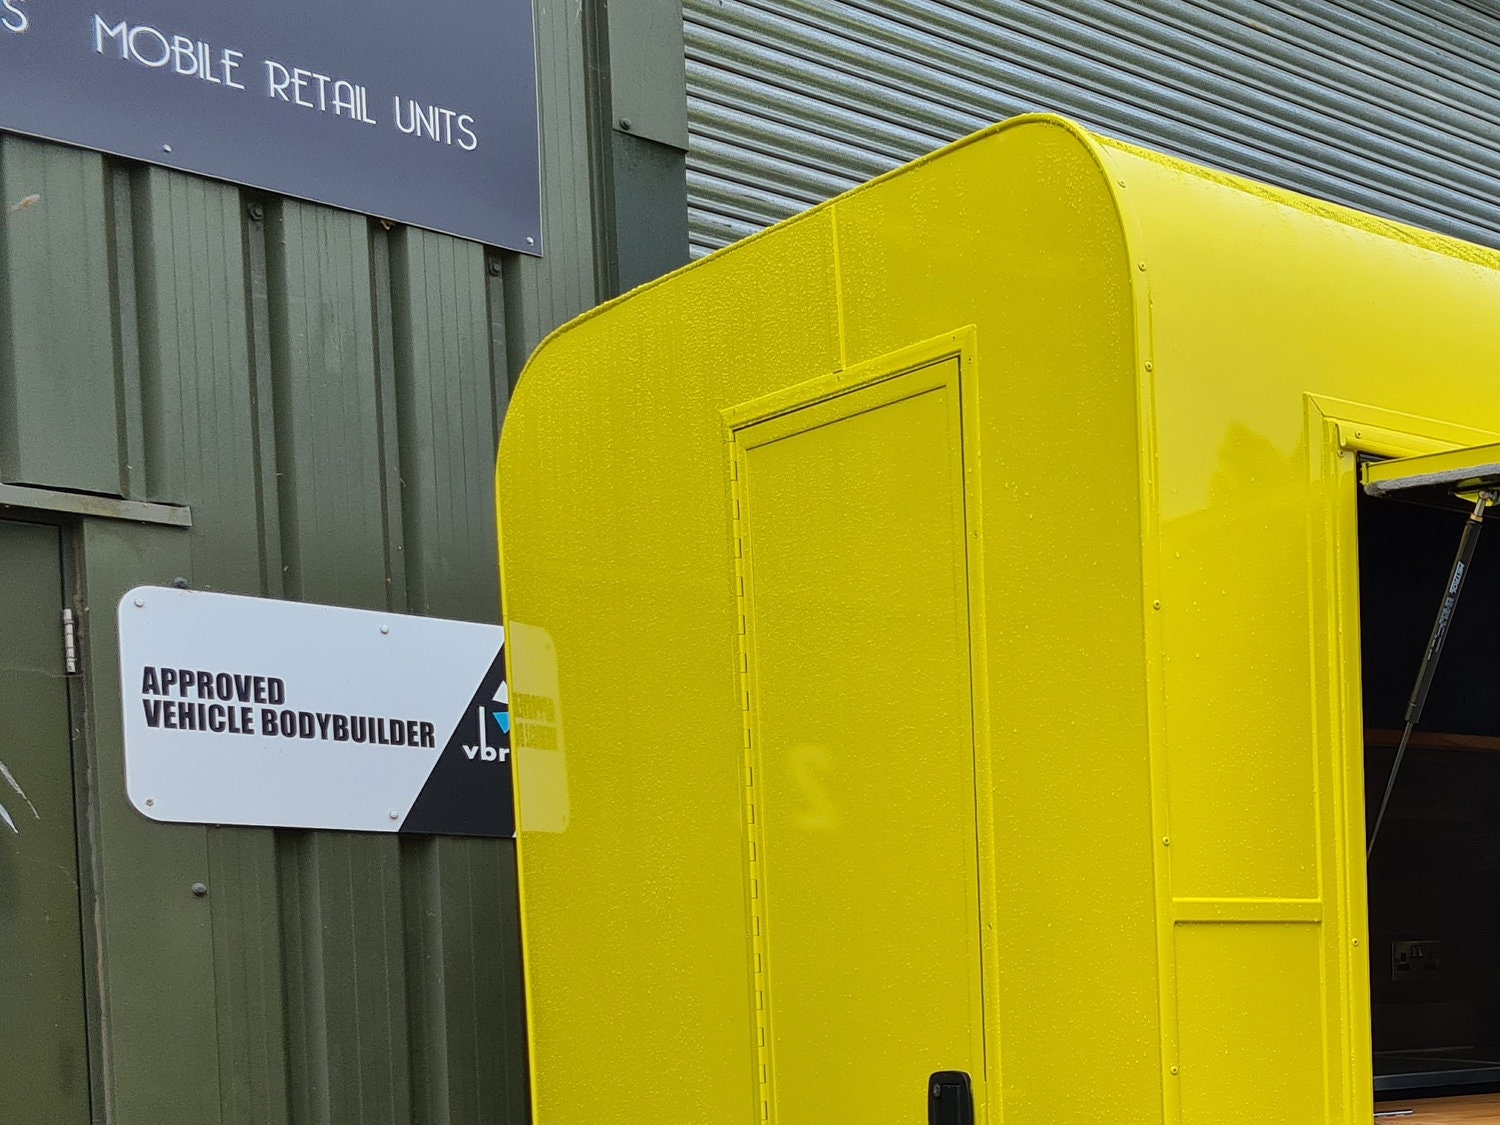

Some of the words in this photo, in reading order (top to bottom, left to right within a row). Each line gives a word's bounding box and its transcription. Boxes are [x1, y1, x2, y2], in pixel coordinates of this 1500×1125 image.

[94, 14, 246, 90] MOBILE
[265, 59, 377, 125] RETAIL
[394, 95, 479, 151] UNITS
[141, 666, 286, 706] APPROVED
[142, 699, 255, 735] VEHICLE
[261, 711, 436, 749] BODYBUILDER
